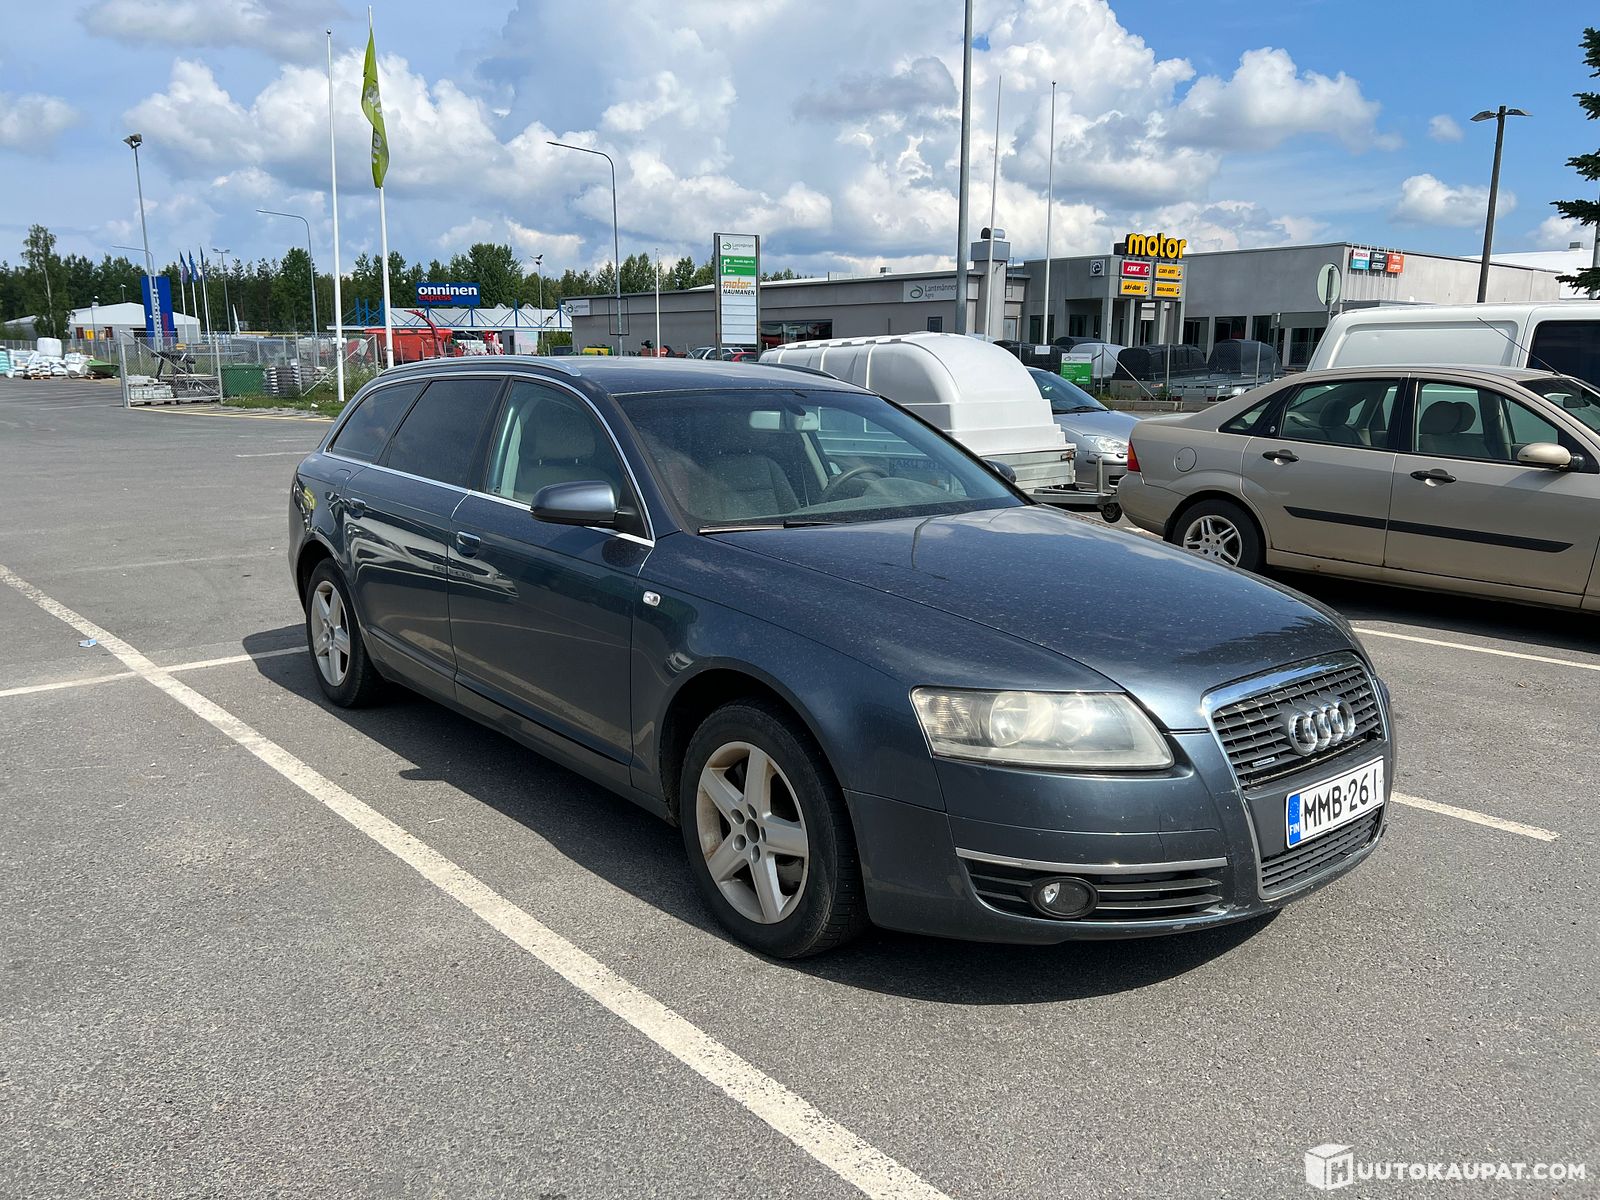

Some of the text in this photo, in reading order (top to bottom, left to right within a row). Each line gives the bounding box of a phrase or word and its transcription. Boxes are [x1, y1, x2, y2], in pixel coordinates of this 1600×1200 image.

[1127, 232, 1187, 259] motor
[418, 283, 477, 296] onninen
[723, 278, 752, 289] motor
[418, 295, 452, 303] express
[1304, 769, 1377, 831] MMB-261
[1289, 822, 1300, 835] FIN
